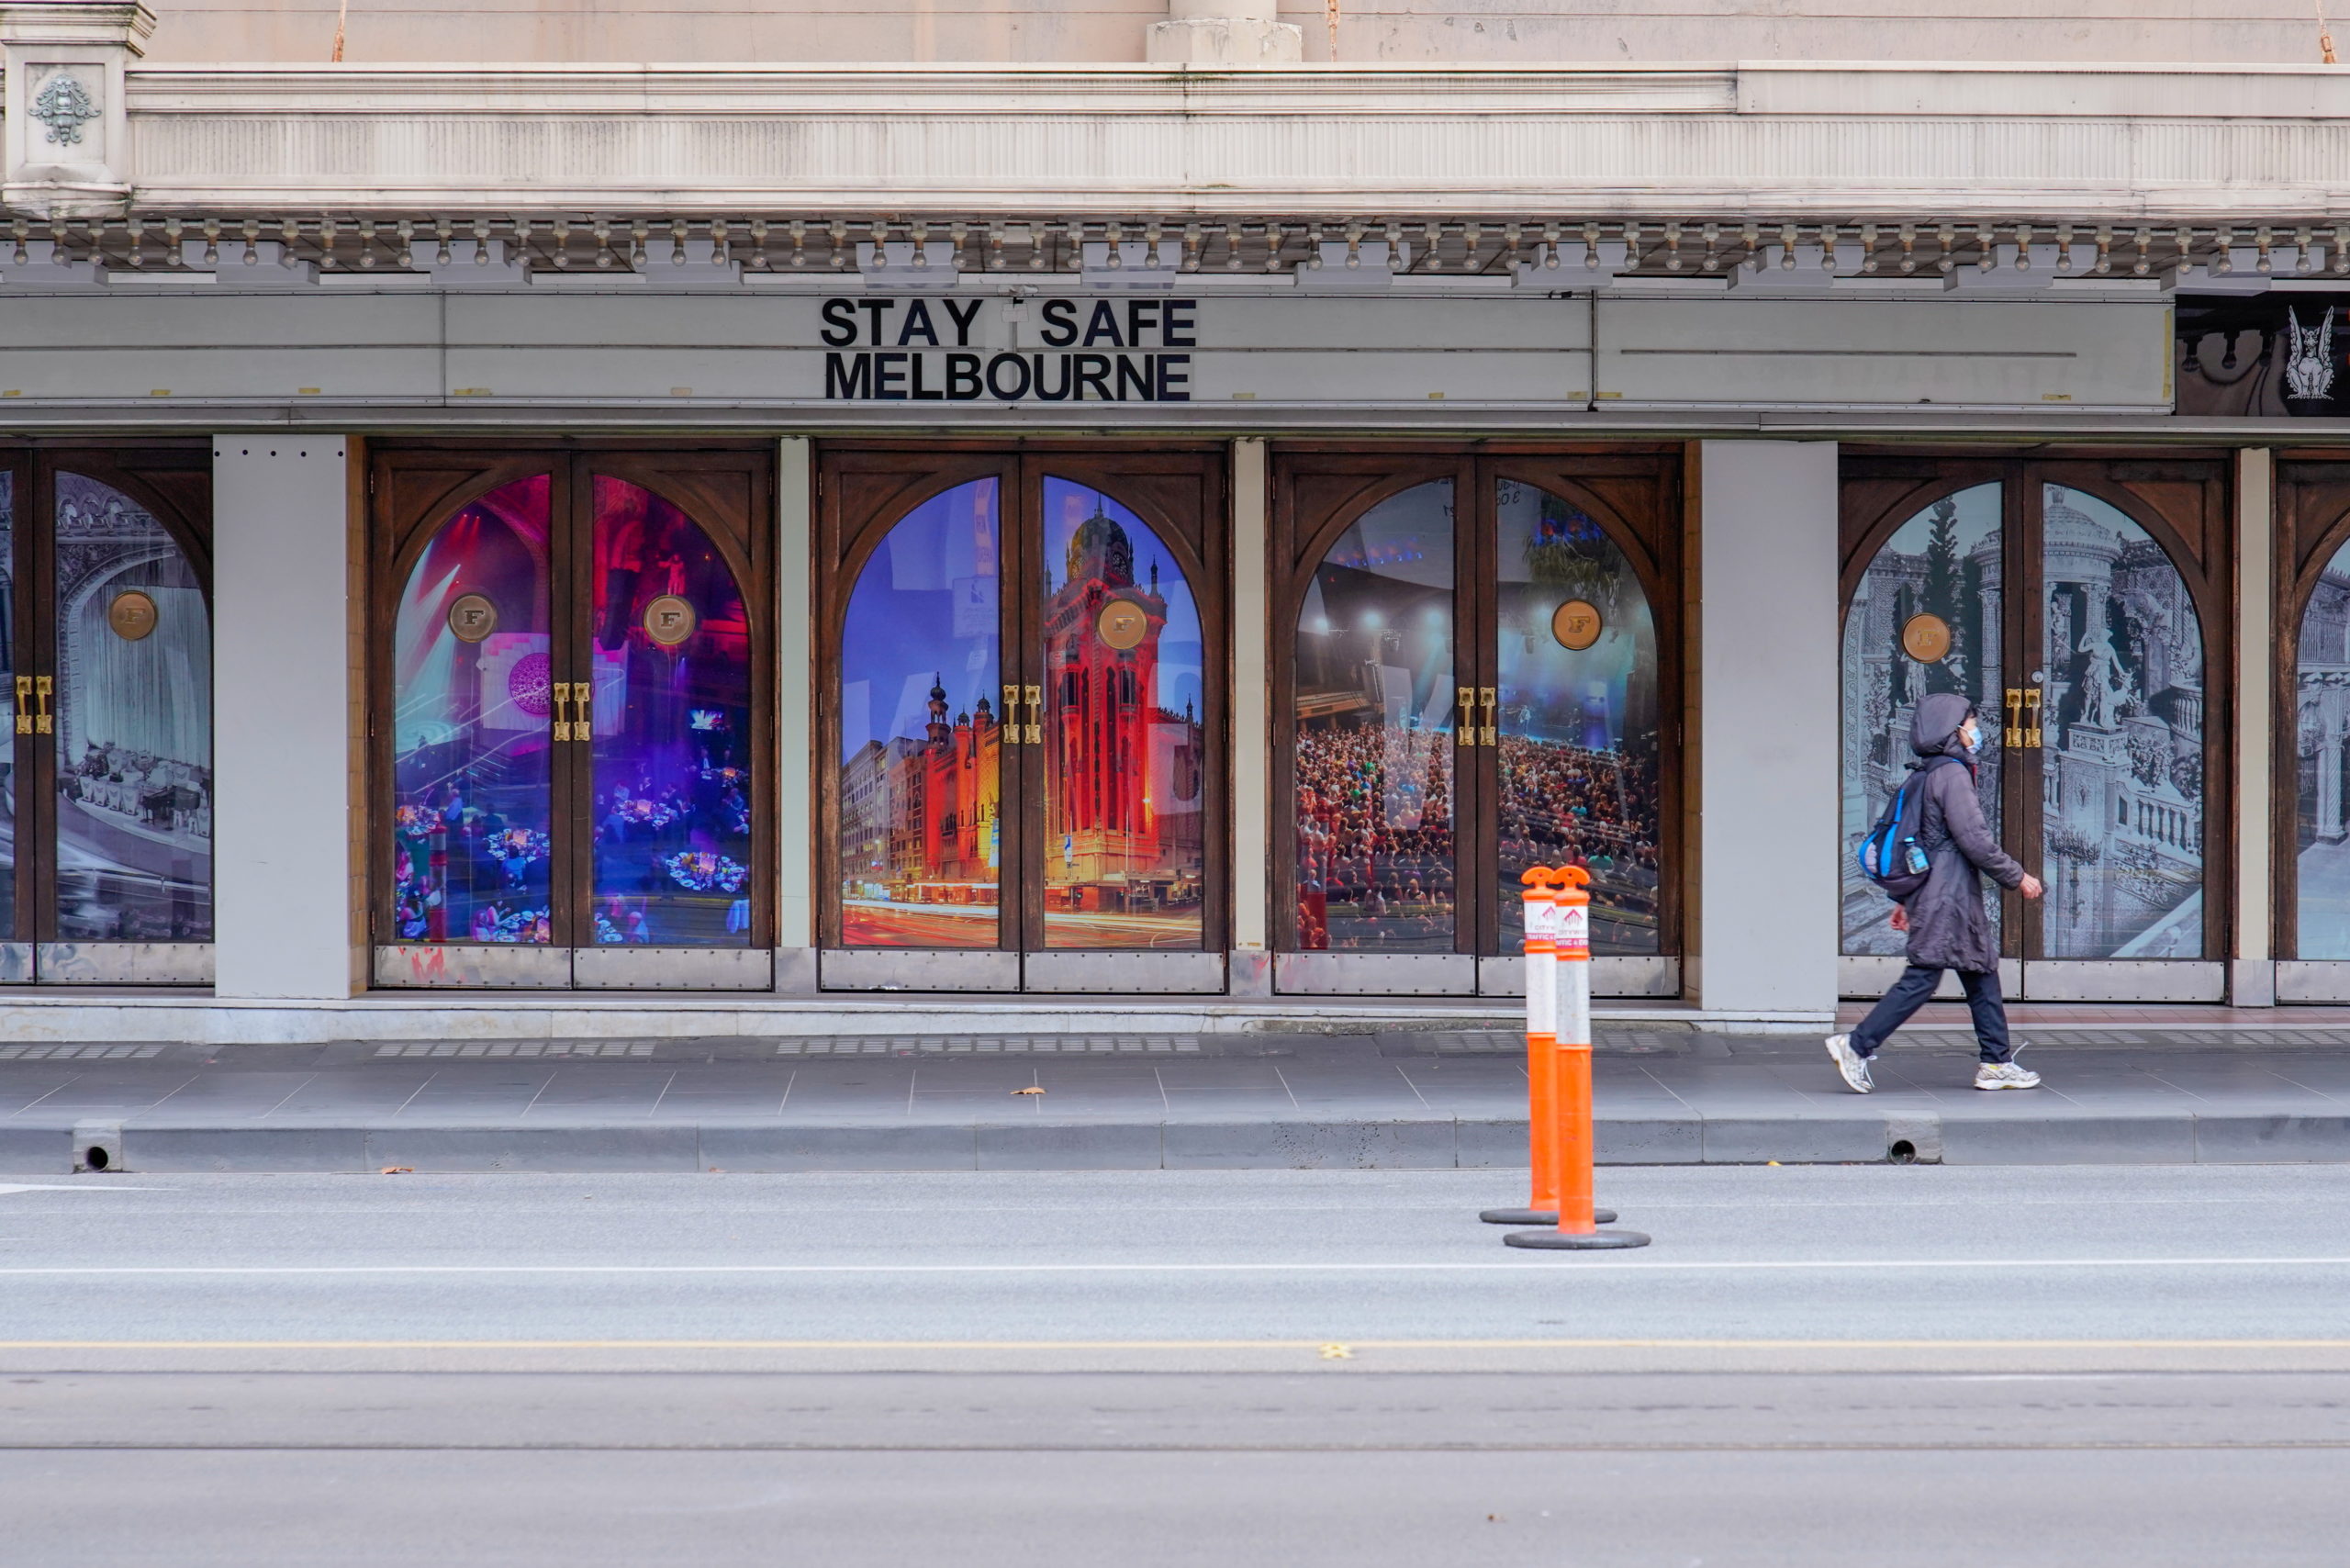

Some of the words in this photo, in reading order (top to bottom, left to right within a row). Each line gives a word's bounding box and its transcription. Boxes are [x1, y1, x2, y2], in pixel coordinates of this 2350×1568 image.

[821, 298, 983, 346] STAY
[1040, 299, 1197, 347] SAFE
[825, 353, 1191, 401] MELBOURNE
[124, 608, 145, 624] F
[464, 610, 485, 625] F
[660, 611, 680, 628] F
[1113, 616, 1136, 633] F
[1568, 616, 1590, 633] F
[1918, 630, 1938, 647] F
